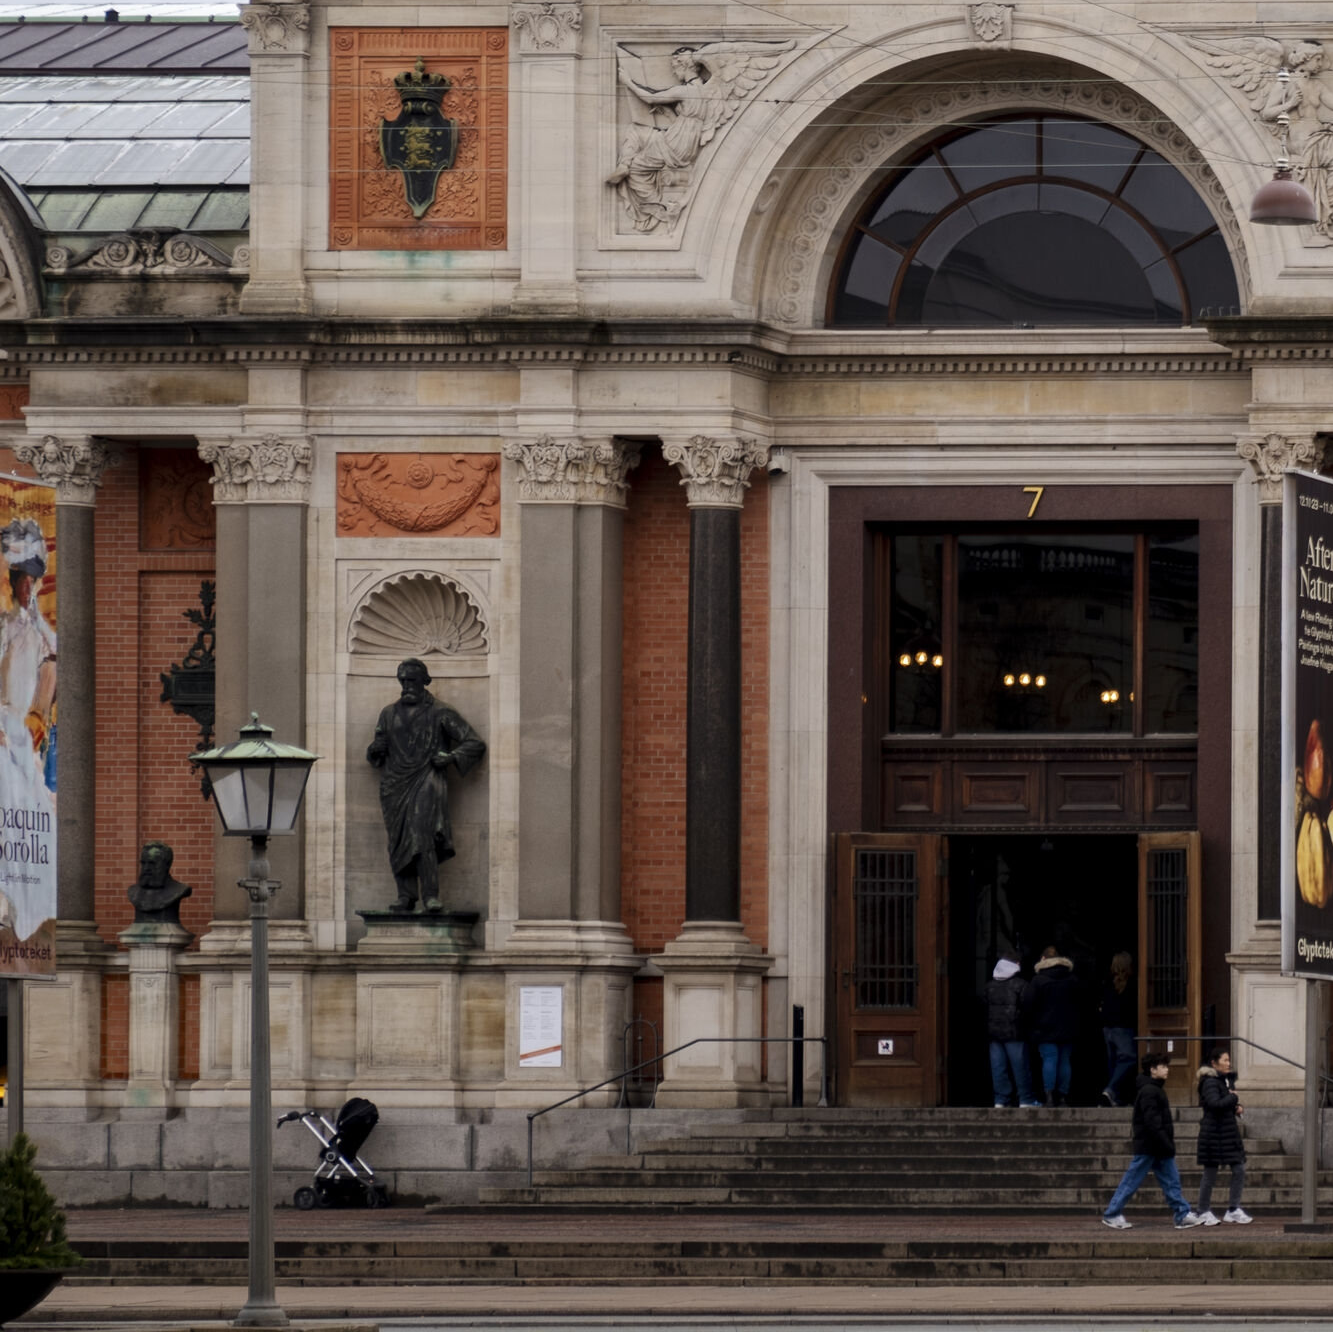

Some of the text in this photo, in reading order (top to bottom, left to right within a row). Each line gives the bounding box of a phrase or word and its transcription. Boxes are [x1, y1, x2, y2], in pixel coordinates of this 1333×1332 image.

[1023, 486, 1044, 518] 7
[0, 802, 51, 839] oaquín
[0, 939, 52, 964] lyptoteket
